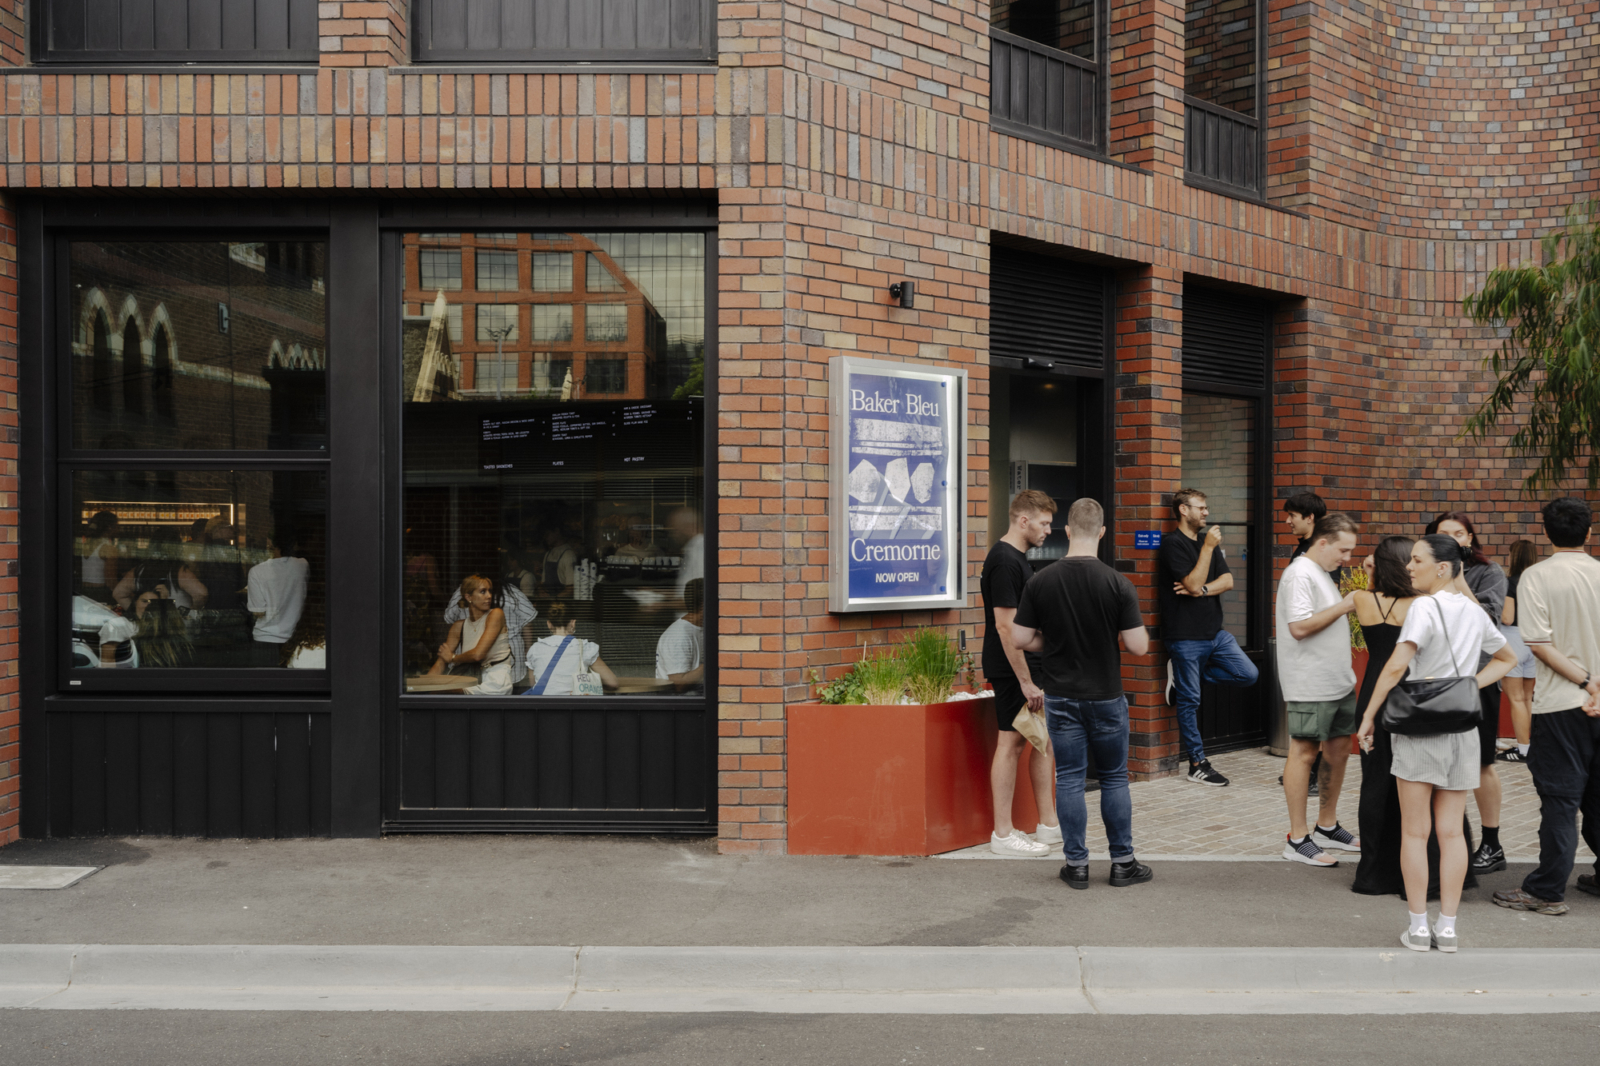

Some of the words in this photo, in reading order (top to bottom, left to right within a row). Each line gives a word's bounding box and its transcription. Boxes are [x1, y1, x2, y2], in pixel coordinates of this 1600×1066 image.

[851, 389, 900, 414] Baker
[906, 394, 939, 417] Bleu
[851, 538, 941, 562] Cremorne
[875, 573, 896, 583] NOW
[897, 572, 919, 582] OPEN
[577, 673, 591, 682] RED
